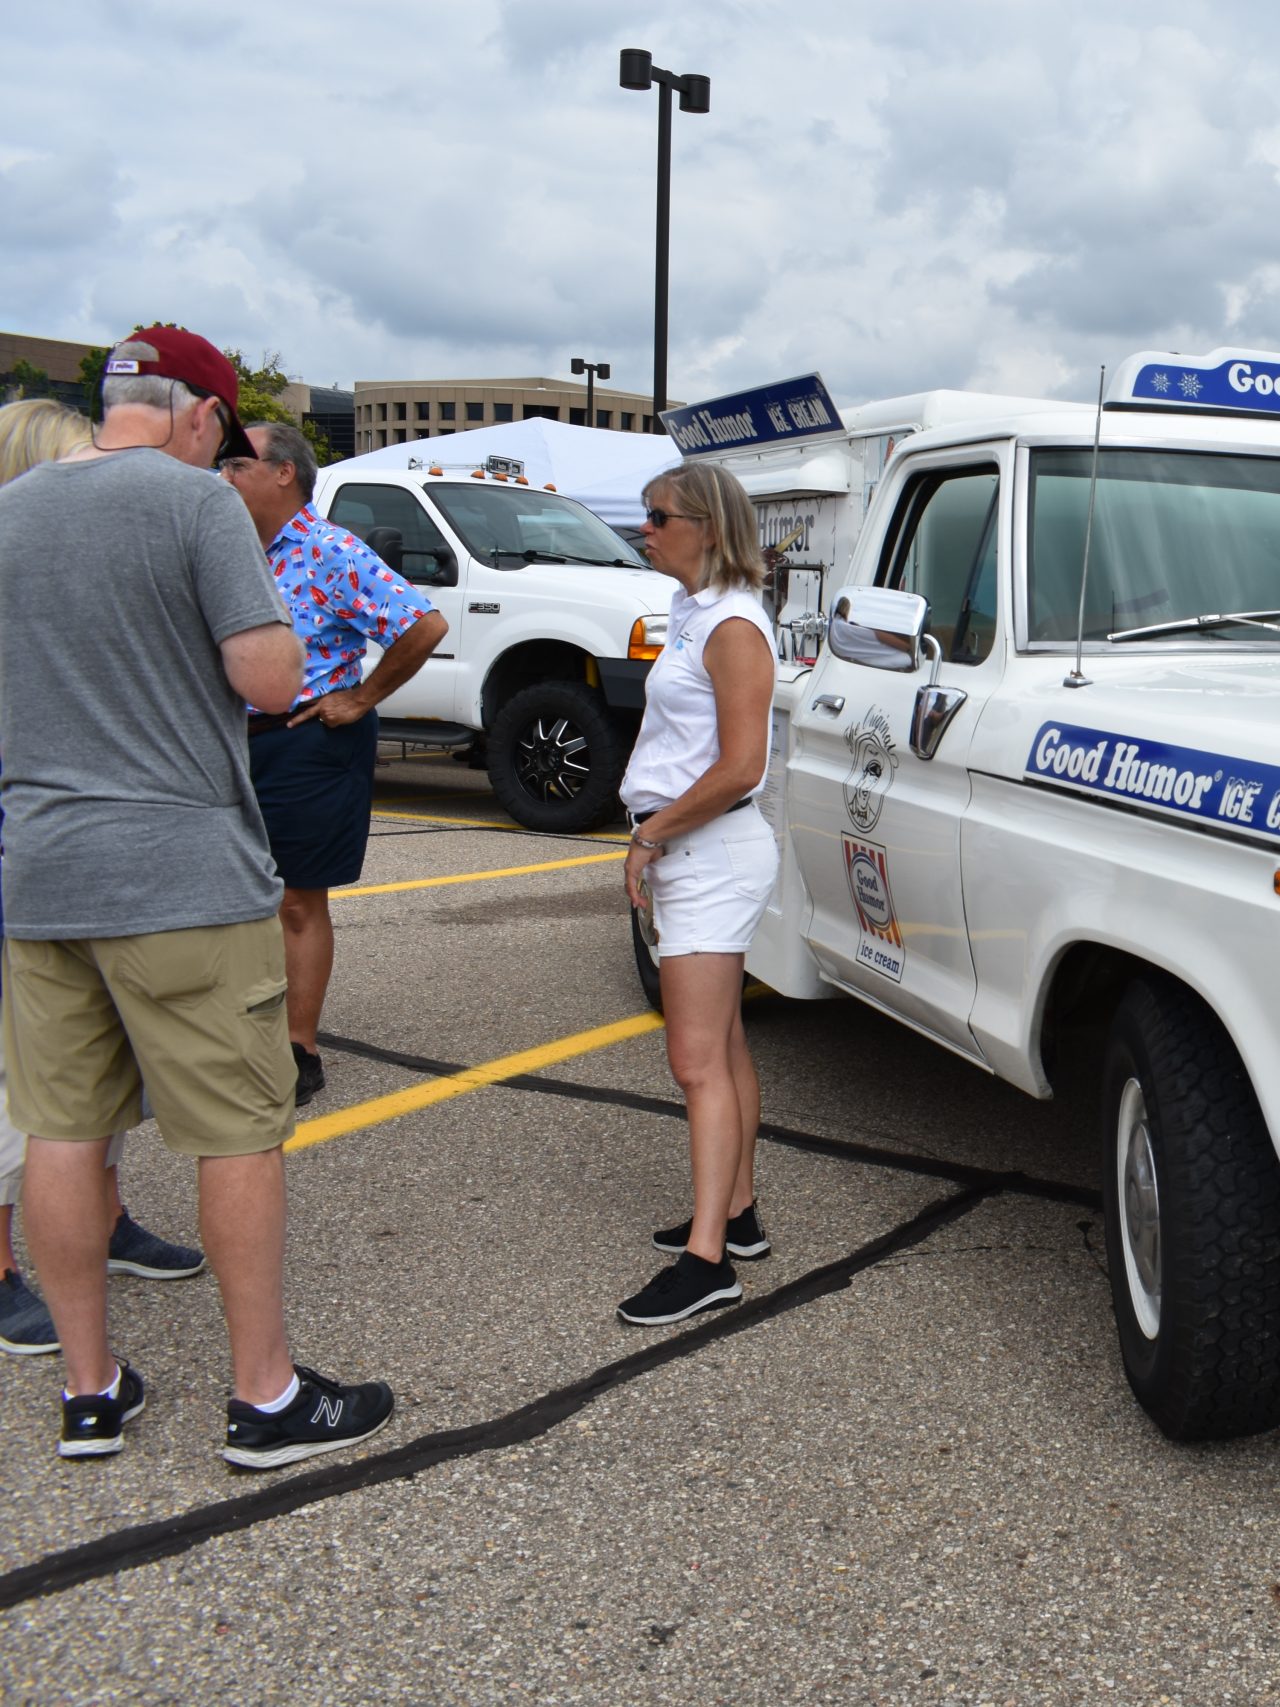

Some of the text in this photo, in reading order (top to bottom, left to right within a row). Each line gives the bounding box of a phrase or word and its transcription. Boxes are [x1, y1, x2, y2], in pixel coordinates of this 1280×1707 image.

[668, 393, 832, 450] Good Humor ICE CREAM
[1035, 728, 1109, 783] Good
[1103, 741, 1214, 810] Humor
[1218, 776, 1264, 823] ICE
[857, 868, 879, 893] Good
[856, 885, 885, 912] Humor
[861, 940, 900, 975] ice cream
[310, 1395, 343, 1427] N
